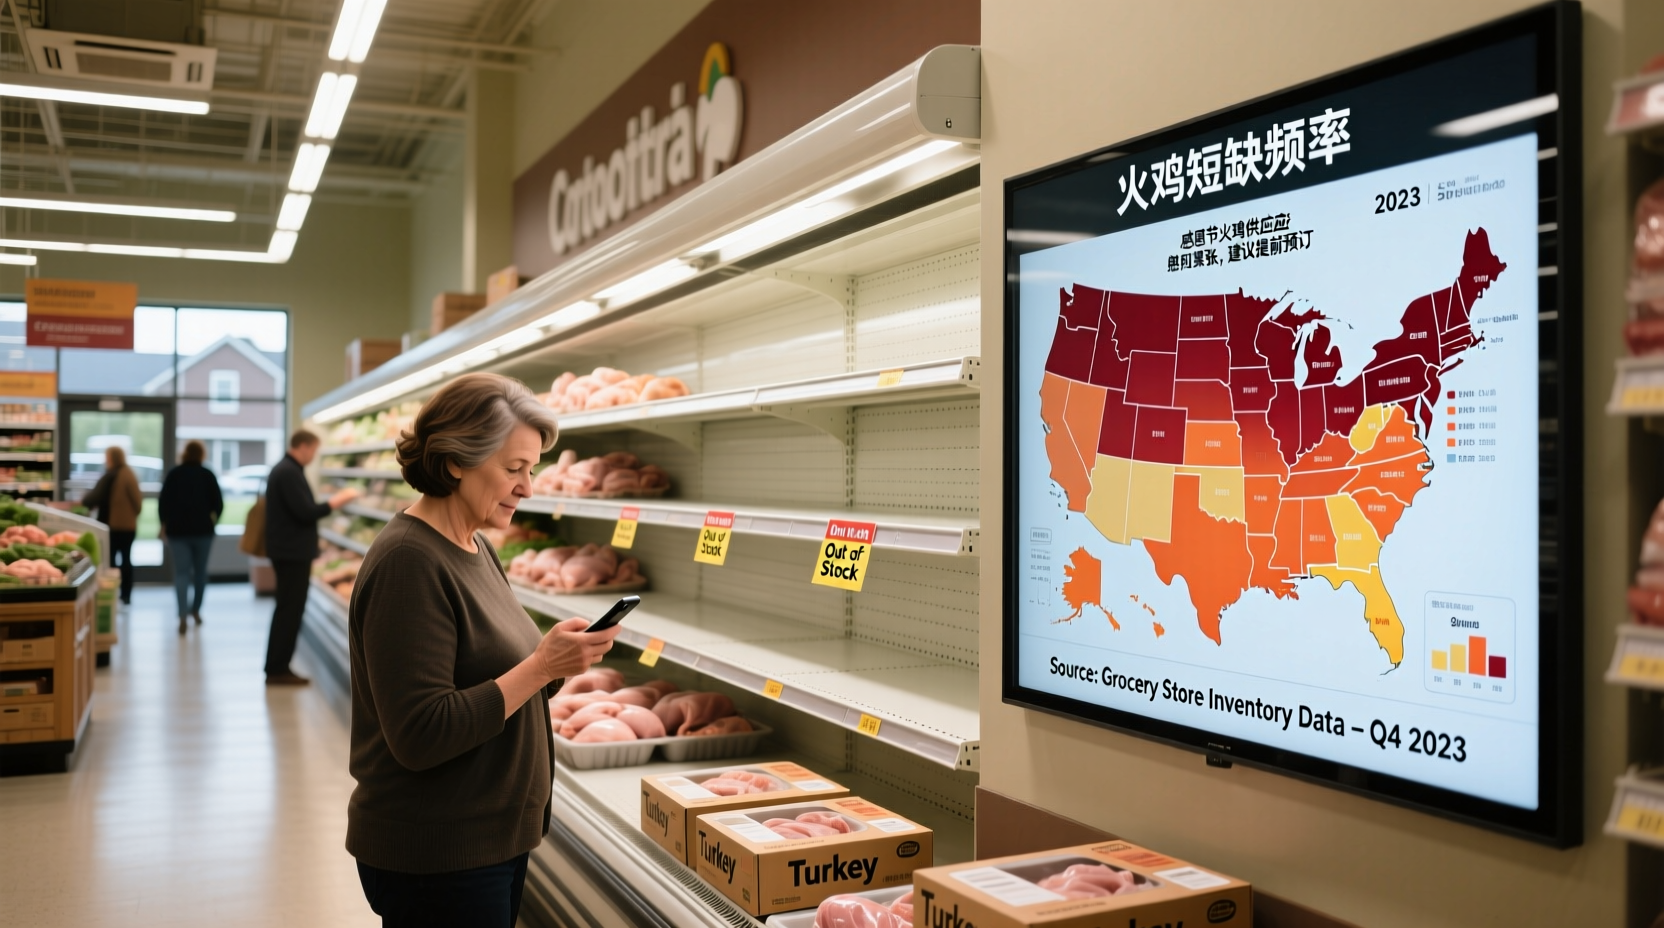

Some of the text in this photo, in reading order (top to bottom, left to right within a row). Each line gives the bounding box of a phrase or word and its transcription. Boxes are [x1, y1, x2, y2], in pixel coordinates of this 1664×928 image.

[1116, 108, 1351, 217] 火鸡短缺频率
[1374, 186, 1422, 215] 2023
[824, 542, 848, 560] Out
[820, 560, 860, 582] Stock
[1050, 656, 1098, 684] Source:
[1101, 666, 1159, 702] Grocery
[1162, 678, 1205, 707] Store
[1208, 687, 1294, 732] Inventory
[1298, 704, 1345, 737] Data
[1369, 718, 1402, 750] Q4
[1407, 726, 1468, 763] 2023
[698, 829, 737, 885] Turkey
[787, 853, 879, 887] Turkey
[920, 888, 978, 928] Turk
